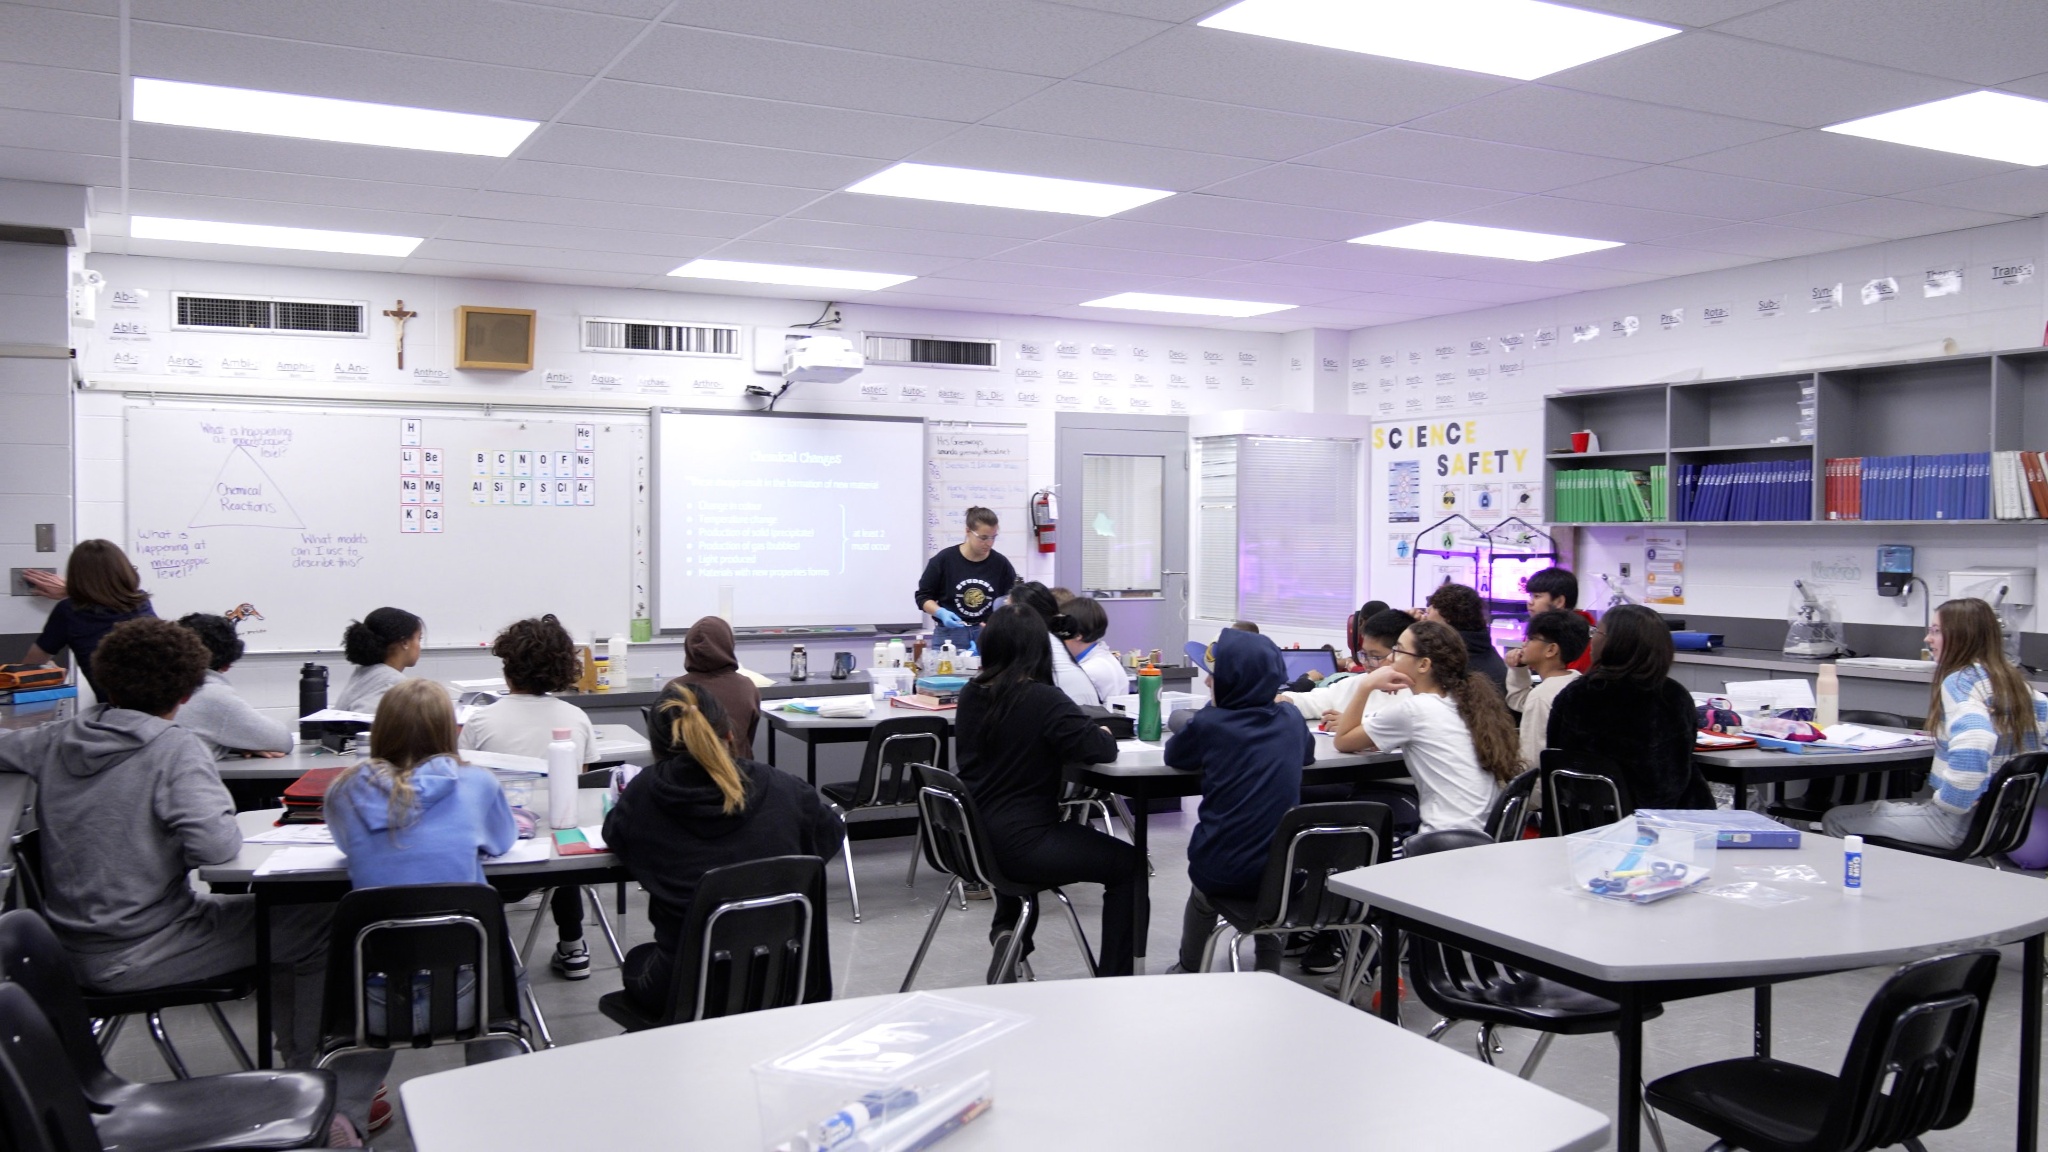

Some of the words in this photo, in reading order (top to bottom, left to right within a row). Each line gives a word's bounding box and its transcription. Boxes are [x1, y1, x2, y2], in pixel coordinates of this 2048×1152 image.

[408, 423, 414, 432] H
[578, 428, 590, 437] He
[1372, 421, 1477, 449] SCIENCE
[403, 452, 412, 461] Li
[425, 452, 438, 462] Be
[478, 454, 484, 463] B
[499, 454, 505, 464] C
[519, 455, 526, 464] N
[540, 455, 547, 464] O
[562, 456, 568, 464] F
[578, 456, 590, 465] Ne
[750, 451, 797, 463] Chemical
[799, 451, 843, 466] Changes
[1437, 448, 1528, 477] SAFETY
[403, 481, 416, 490] Na
[425, 481, 441, 492] Mg
[472, 482, 482, 491] Al
[494, 482, 503, 492] Si
[519, 483, 526, 492] P
[540, 483, 547, 492] S
[557, 482, 567, 492] Cl
[578, 483, 588, 492] Ar
[774, 478, 786, 488] the
[787, 478, 823, 489] formation
[824, 479, 833, 489] of
[217, 482, 262, 496] Chemical
[220, 497, 277, 513] Reactions
[699, 501, 727, 512] Change
[406, 509, 413, 518] K
[425, 509, 439, 519] Ca
[138, 529, 171, 540] What
[301, 532, 333, 544] What
[699, 528, 741, 538] Production
[742, 528, 750, 537] of
[751, 528, 770, 538] solid
[135, 541, 189, 555] happening
[194, 540, 206, 550] at
[699, 541, 741, 551] Production
[742, 541, 750, 551] of
[852, 543, 869, 552] must
[871, 544, 890, 552] occur
[291, 547, 311, 557] can
[326, 547, 343, 556] use
[347, 546, 358, 556] to
[150, 557, 210, 570] microscopic
[292, 557, 335, 568] describe
[699, 554, 719, 566] Light
[720, 554, 756, 566] produced
[699, 567, 734, 577] Materials
[735, 567, 751, 577] with
[752, 568, 769, 577] new
[769, 568, 807, 579] properties
[955, 578, 995, 593] STUDENT
